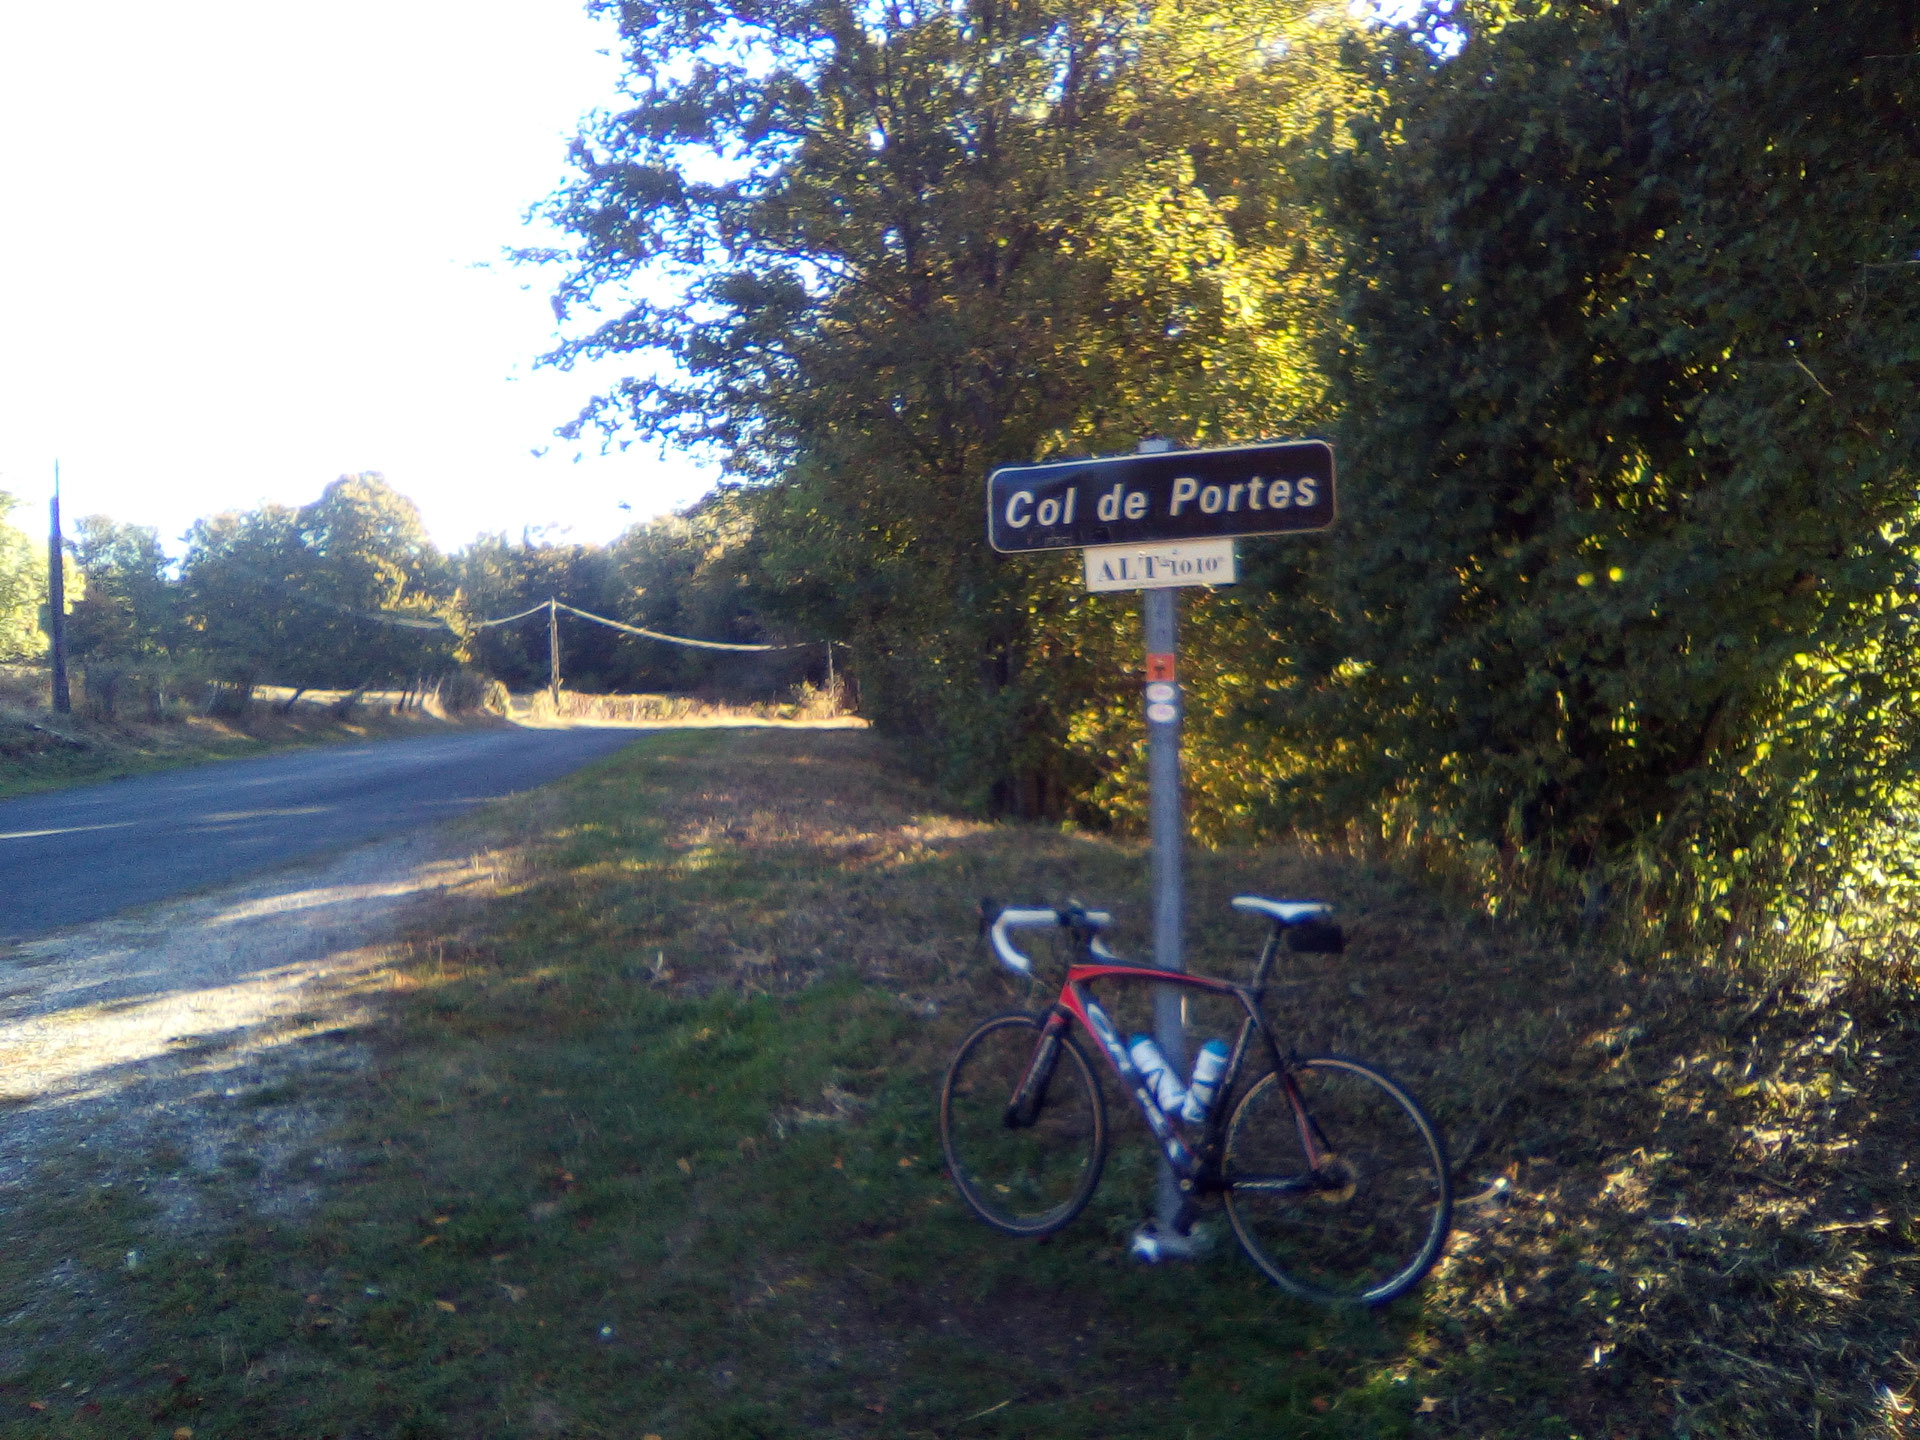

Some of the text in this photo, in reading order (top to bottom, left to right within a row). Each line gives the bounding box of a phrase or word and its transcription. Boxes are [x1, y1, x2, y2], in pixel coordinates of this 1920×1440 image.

[1004, 475, 1319, 529] Col de Portes
